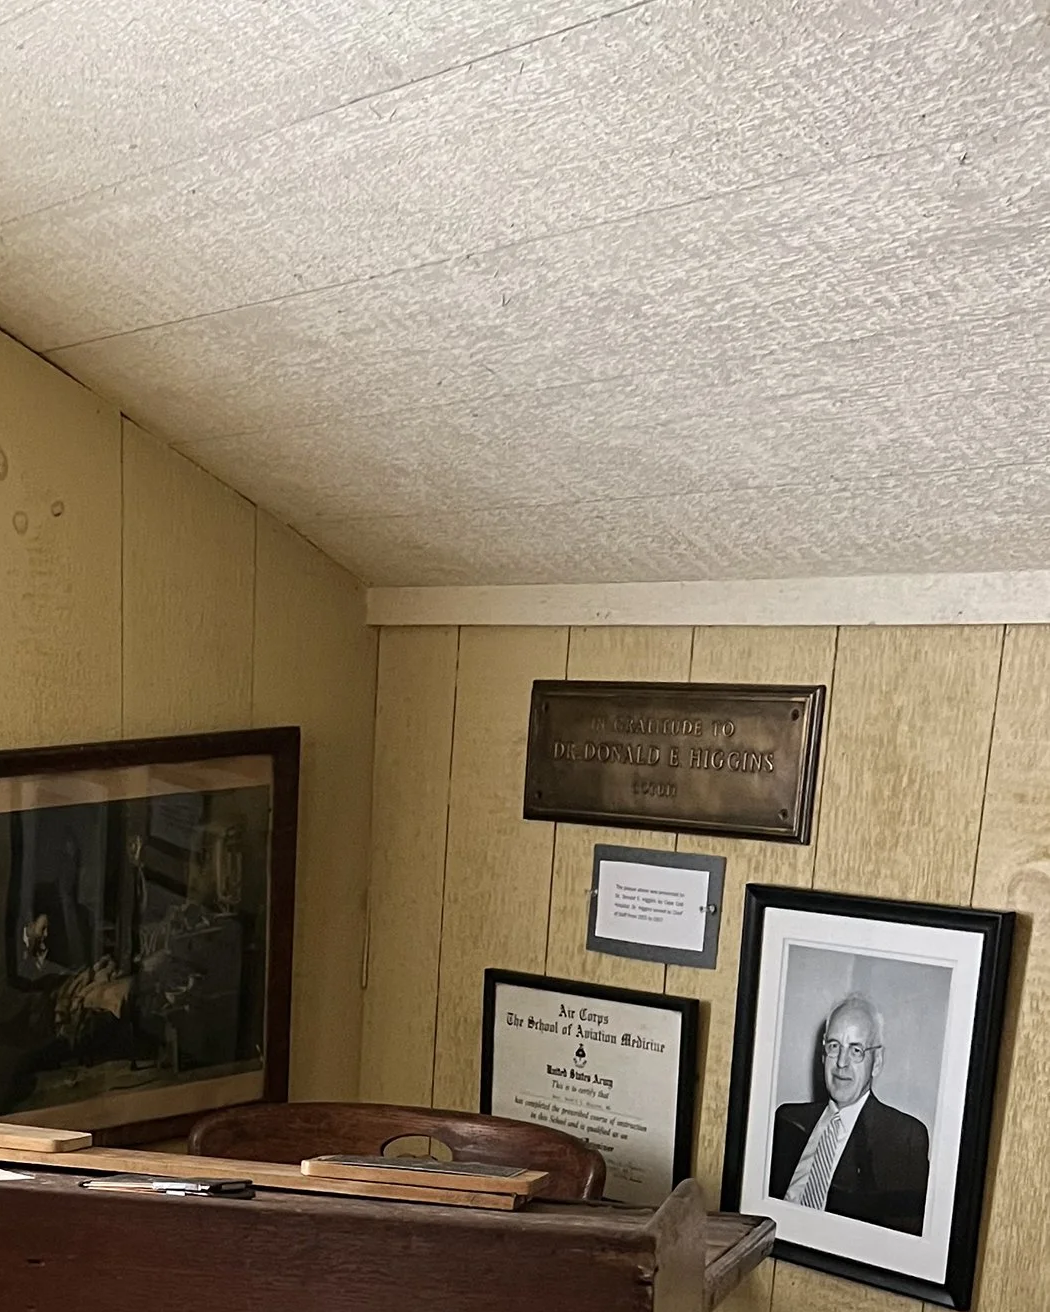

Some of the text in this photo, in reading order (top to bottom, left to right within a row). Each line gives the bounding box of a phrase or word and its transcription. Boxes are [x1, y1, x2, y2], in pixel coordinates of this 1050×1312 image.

[711, 719, 735, 738] TO
[583, 743, 660, 766] DONALD
[689, 750, 774, 773] HIGGINS
[558, 1004, 609, 1025] Air Corps
[506, 1012, 666, 1053] The School of Aviation Medicine
[546, 1064, 614, 1089] United States Army
[552, 1080, 564, 1090] This
[578, 1086, 596, 1098] certify
[598, 1090, 610, 1100] that
[524, 1098, 550, 1112] completed
[552, 1103, 560, 1112] the
[562, 1106, 589, 1120] prescribed
[610, 1116, 616, 1127] of
[616, 1119, 648, 1132] instruction
[550, 1113, 566, 1126] School
[568, 1120, 579, 1130] and
[586, 1124, 611, 1138] qualified
